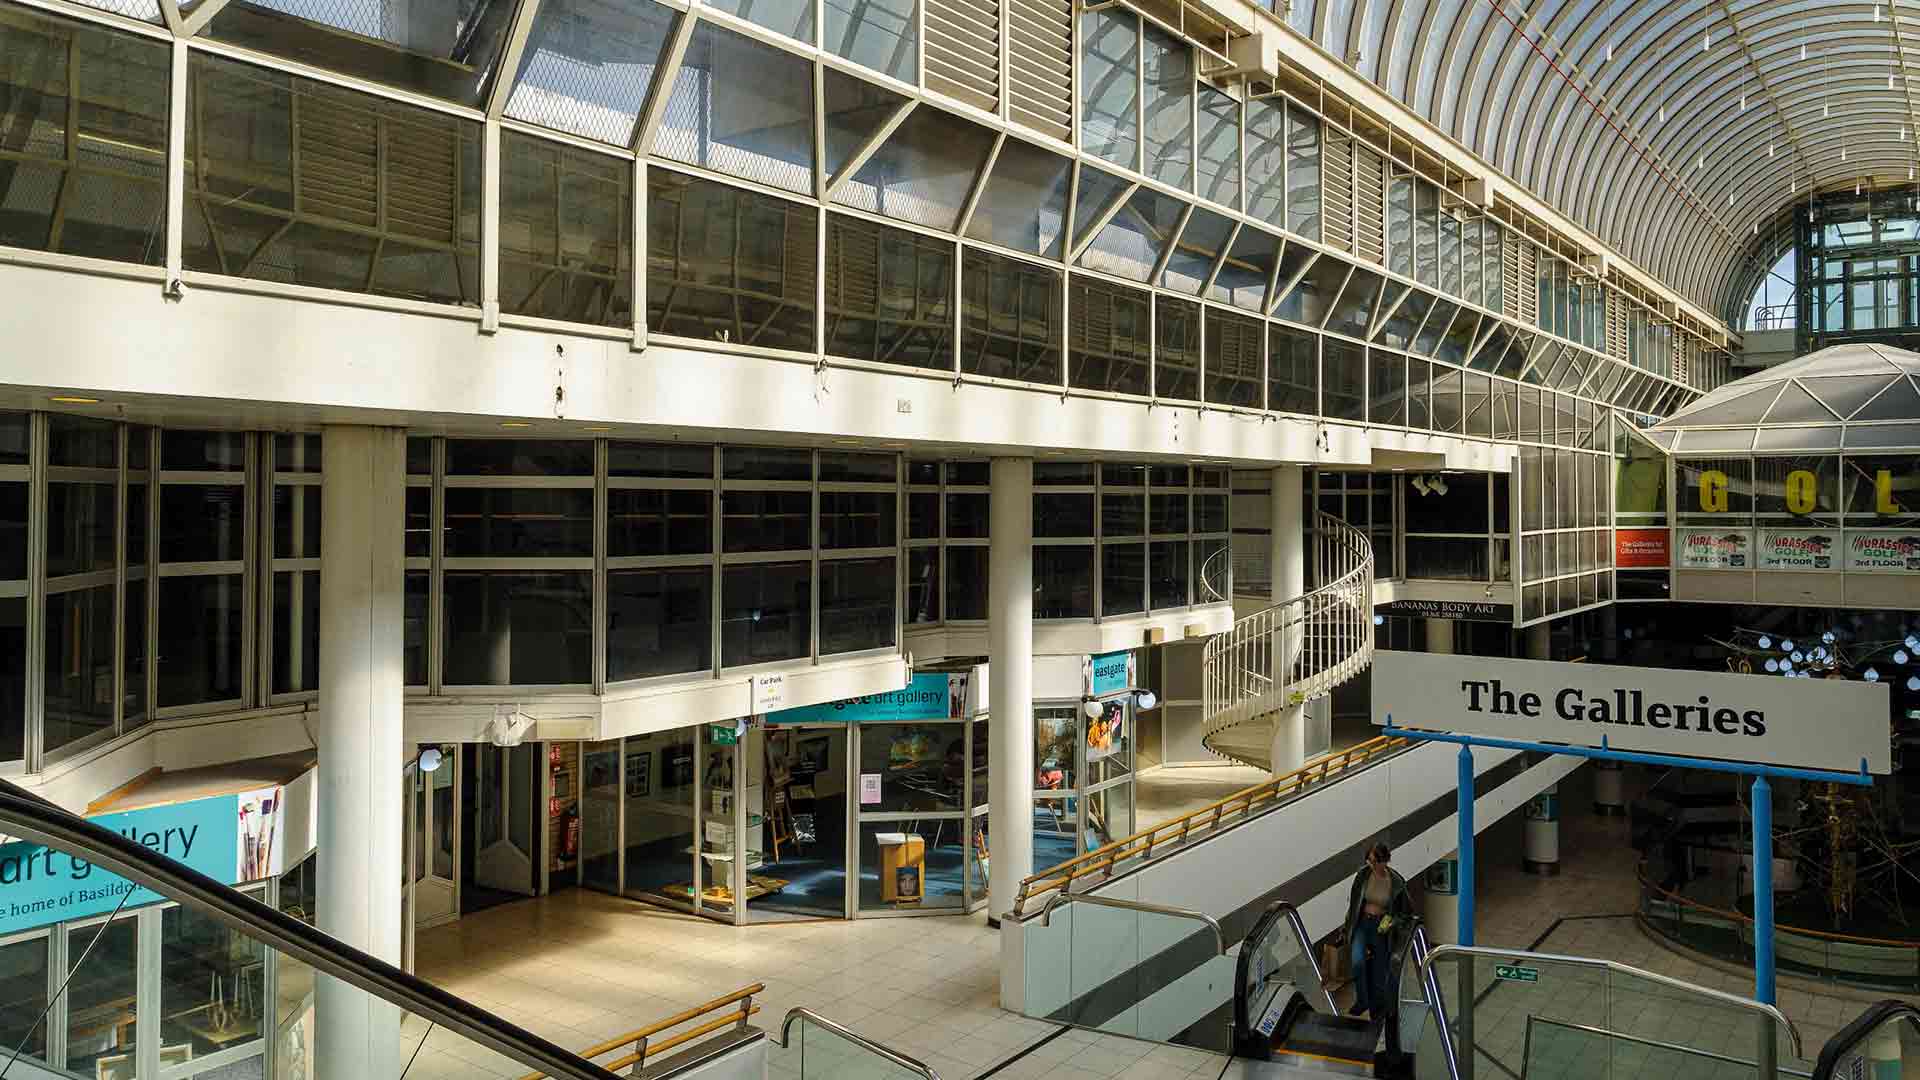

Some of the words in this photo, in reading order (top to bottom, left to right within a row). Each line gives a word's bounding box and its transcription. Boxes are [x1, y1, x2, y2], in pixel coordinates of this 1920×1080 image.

[1391, 602, 1439, 610] BANANAS
[1441, 602, 1471, 612] BODY
[1474, 604, 1496, 614] ART
[1095, 664, 1125, 678] eastgate
[896, 689, 943, 706] gallery
[1461, 679, 1542, 718] The
[1554, 688, 1767, 737] Galleries
[0, 847, 57, 884] art
[10, 900, 55, 917] home
[59, 892, 75, 906] of
